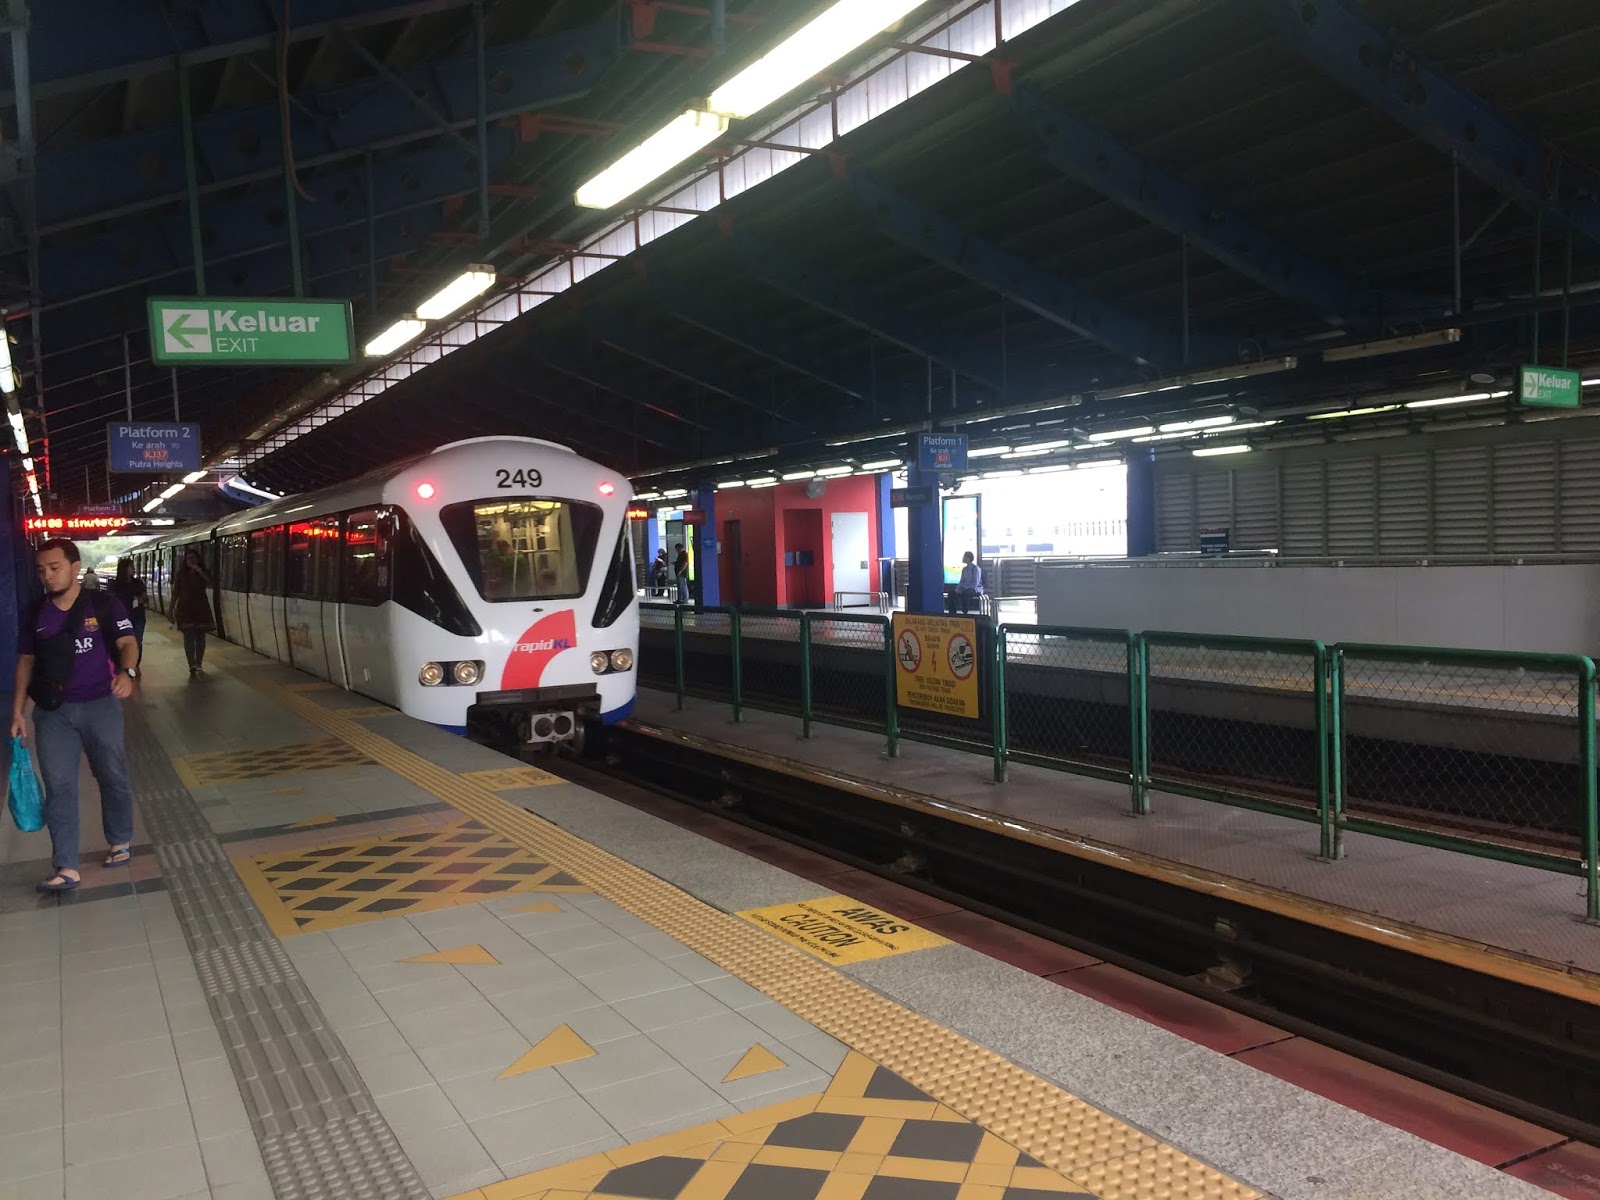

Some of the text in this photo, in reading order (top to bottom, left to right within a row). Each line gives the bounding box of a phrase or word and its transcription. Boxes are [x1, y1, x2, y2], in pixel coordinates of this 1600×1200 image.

[213, 309, 320, 333] Keluar
[216, 337, 259, 353] EXIT
[1538, 373, 1571, 389] Keluar
[119, 427, 190, 438] Platform 2
[131, 441, 143, 449] Ke
[146, 441, 165, 449] arah
[923, 436, 962, 446] Platform 1
[145, 451, 167, 459] KJ37
[129, 460, 183, 470] Putra Heights
[495, 469, 543, 489] 249
[513, 638, 570, 654] rapidKL
[832, 908, 910, 935] AWAS
[779, 913, 866, 948] CAUTION
